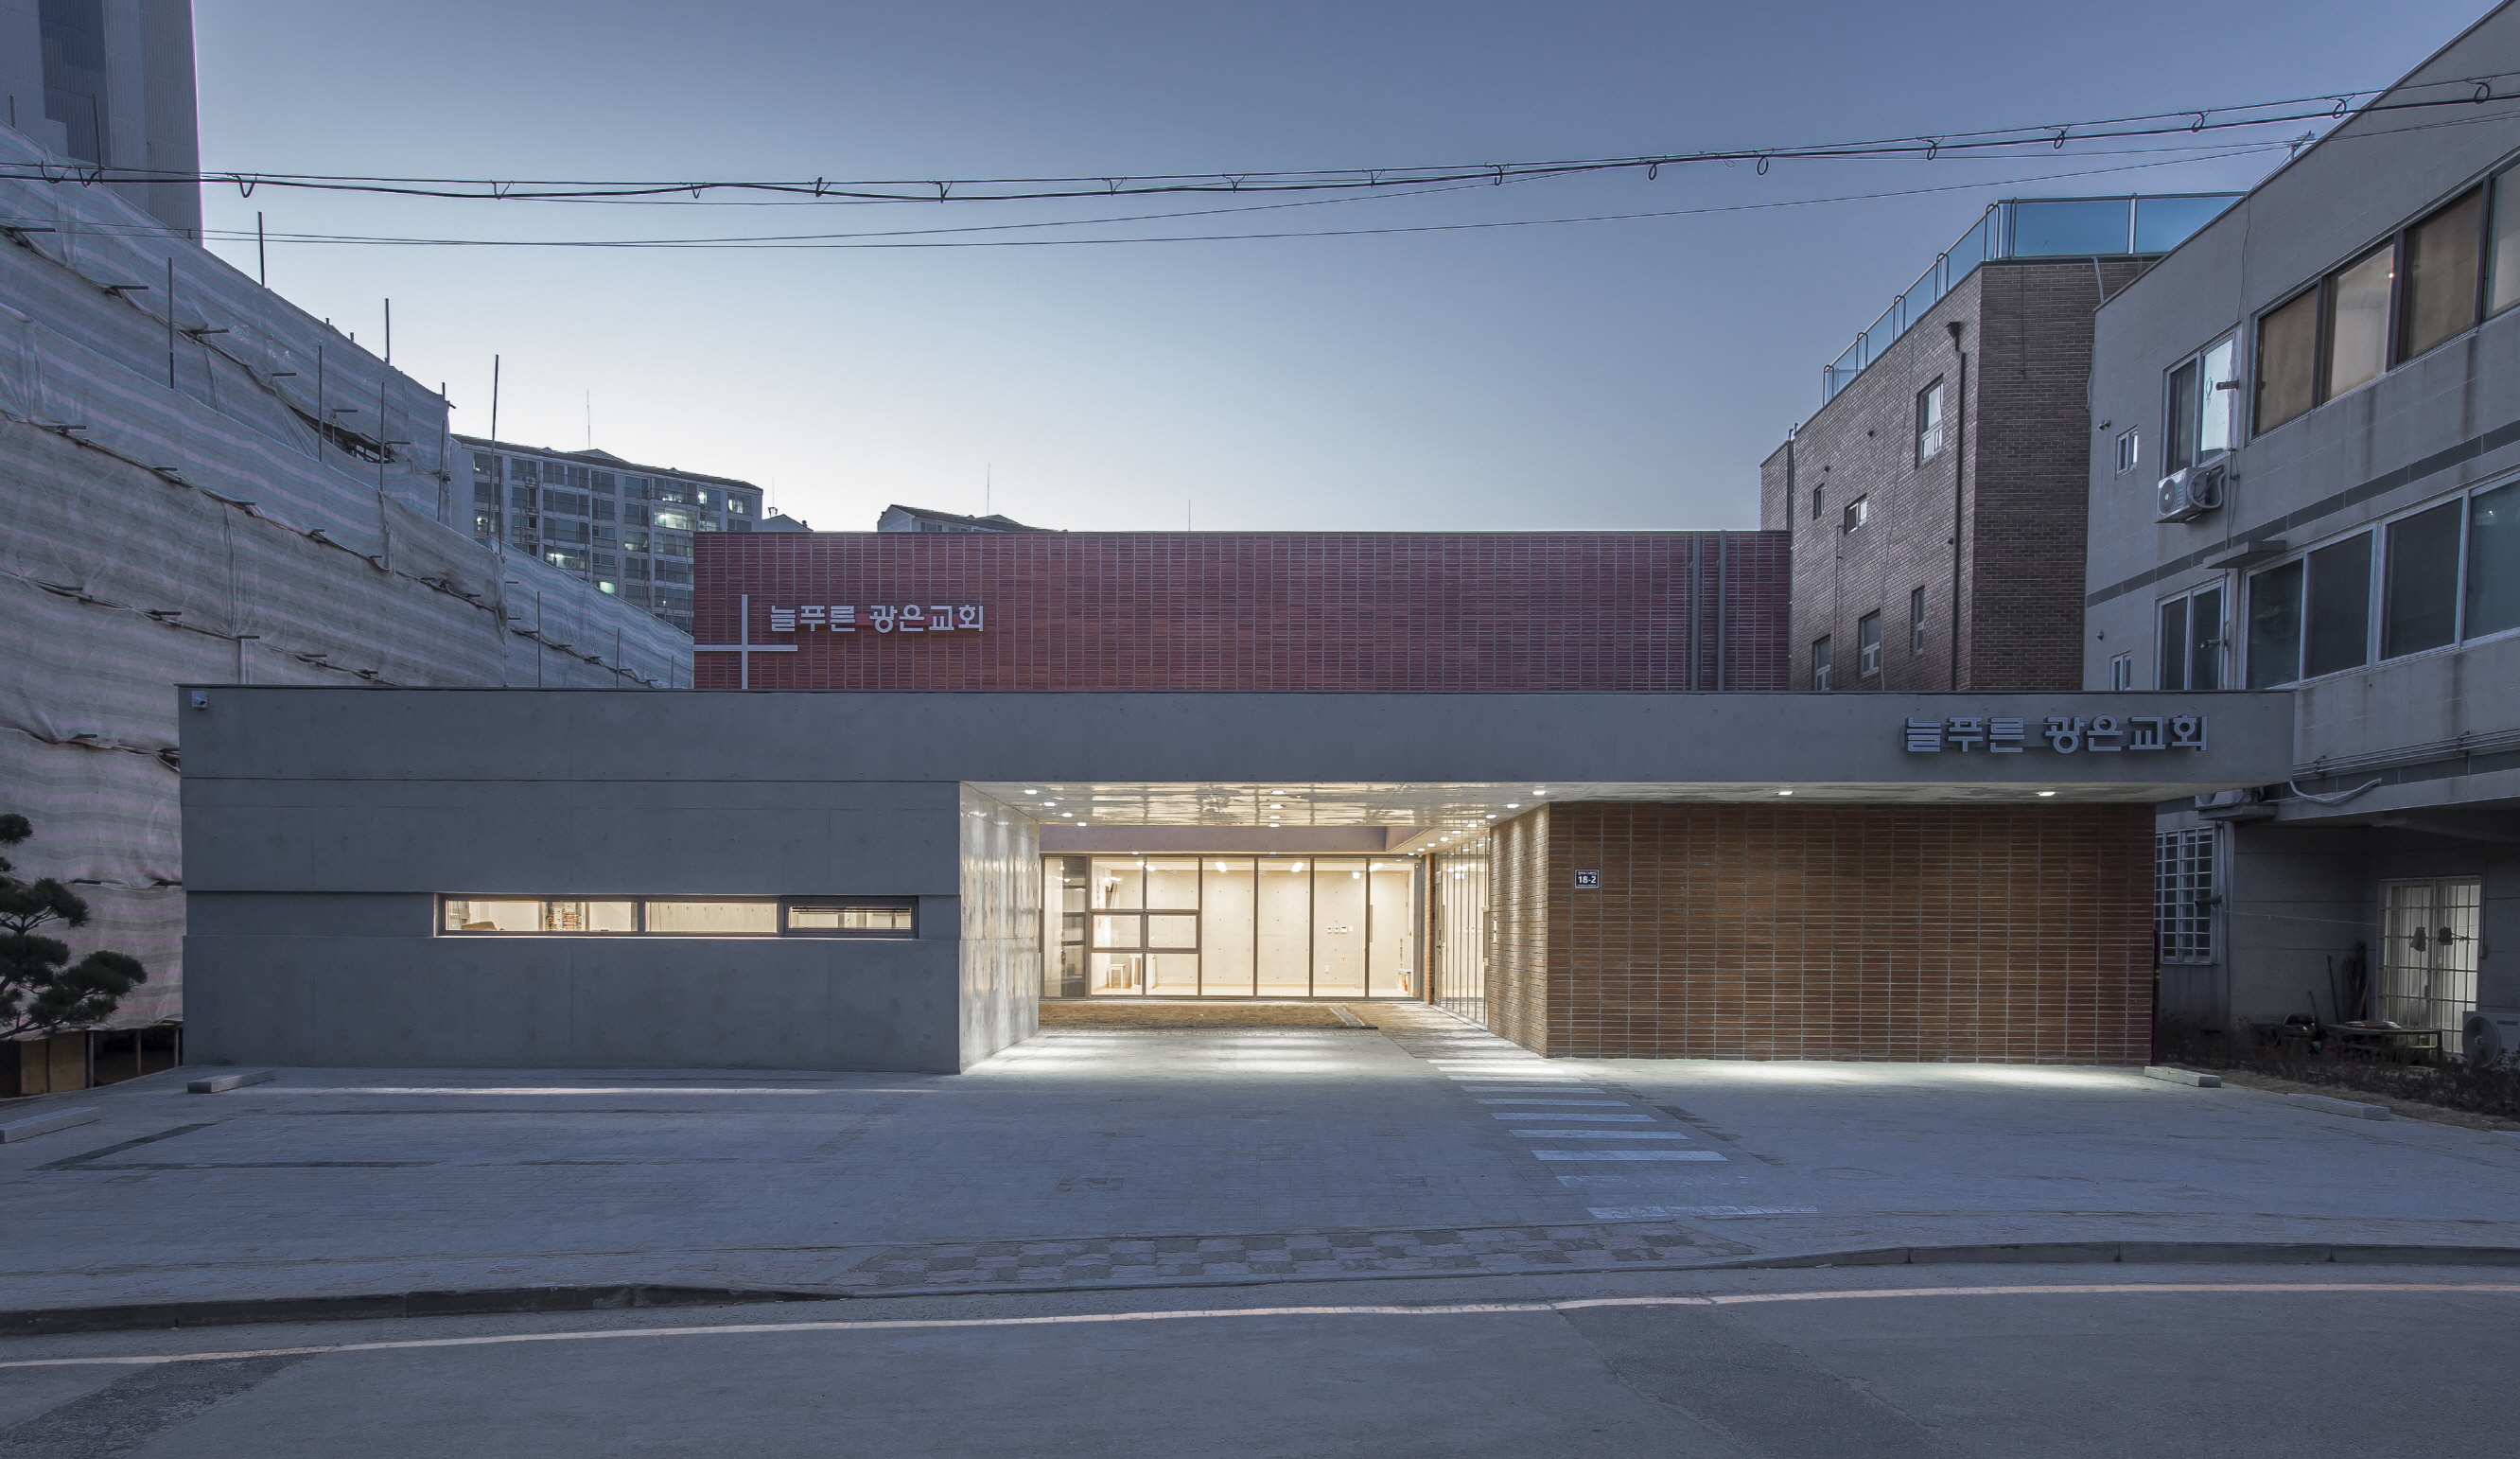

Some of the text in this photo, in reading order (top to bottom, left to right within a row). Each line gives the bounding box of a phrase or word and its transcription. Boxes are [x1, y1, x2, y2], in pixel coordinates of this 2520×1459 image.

[770, 604, 984, 633] 늘푸른 광은교회
[1905, 714, 2208, 754] 늘푸른 광은교회
[1578, 875, 1597, 884] 18-2
